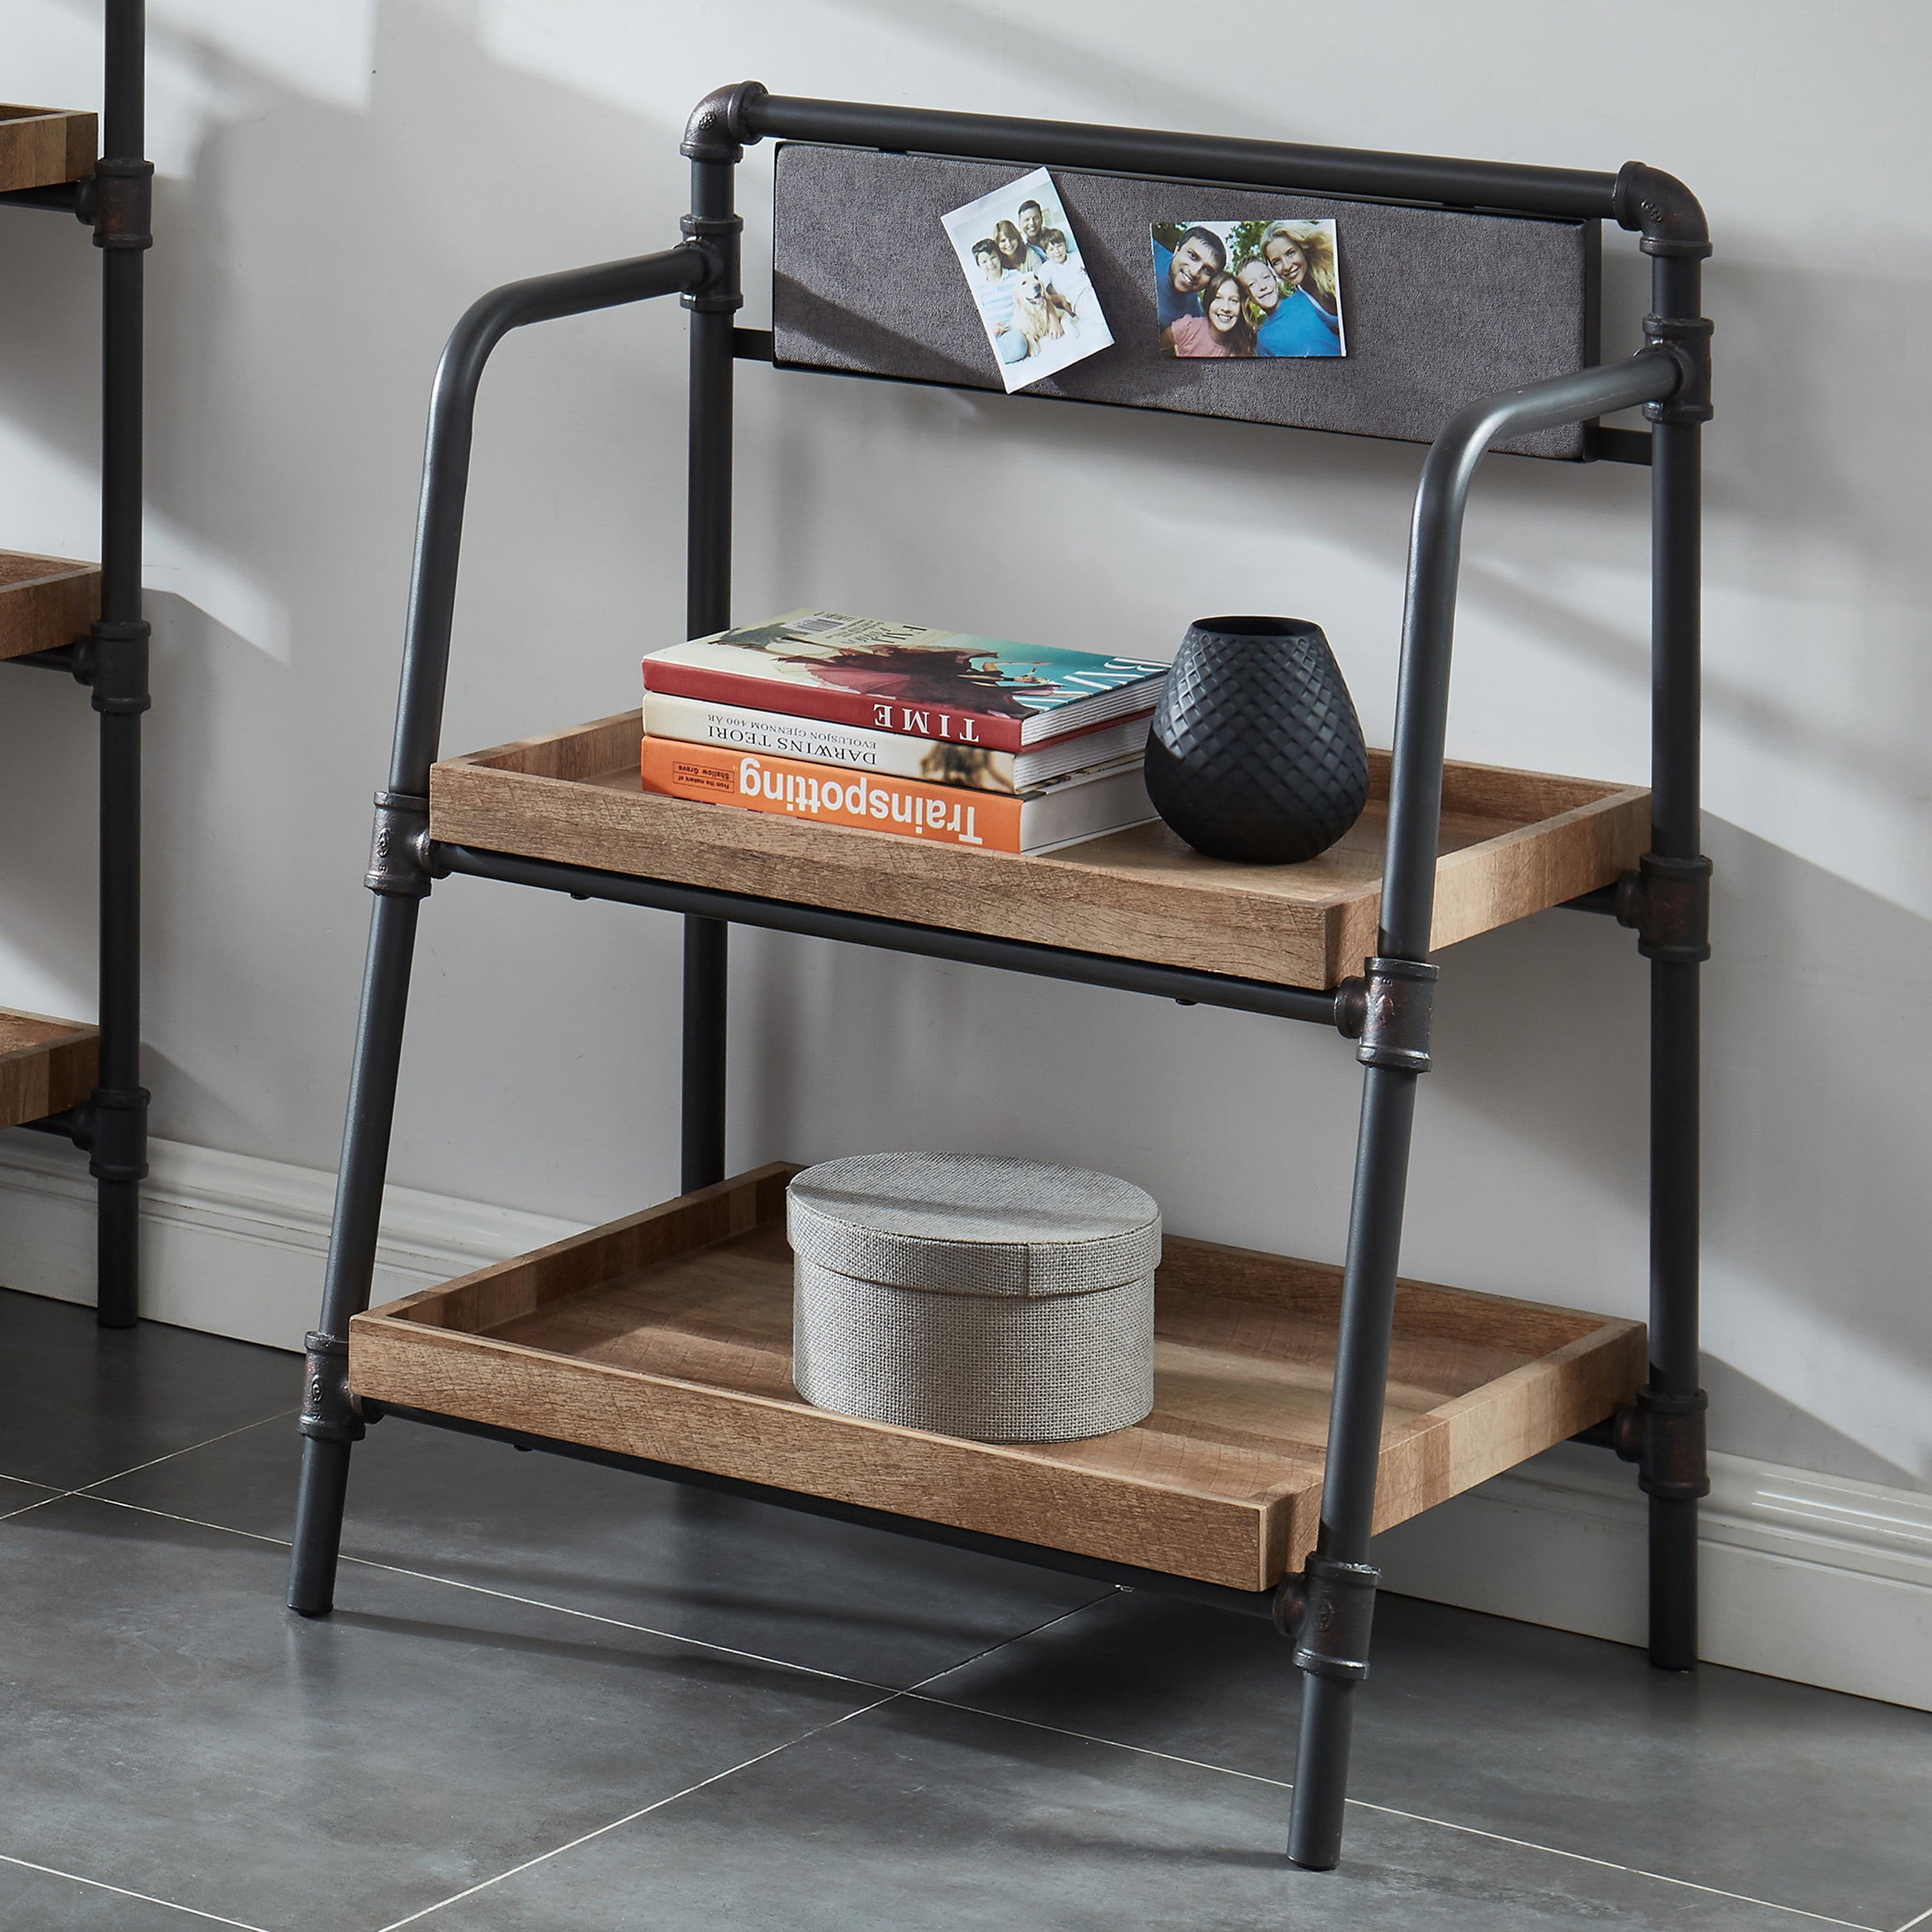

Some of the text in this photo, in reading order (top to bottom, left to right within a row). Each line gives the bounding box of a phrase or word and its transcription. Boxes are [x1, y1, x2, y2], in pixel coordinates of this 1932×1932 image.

[726, 717, 747, 727] 400
[750, 721, 807, 737] GJENNOM
[873, 703, 980, 743] TIME
[708, 725, 877, 765] DARWINS TEORI
[810, 732, 876, 749] EVOLUSJON
[678, 764, 699, 775] Grave
[702, 768, 730, 780] Shallow
[739, 757, 983, 846] Trainspotting
